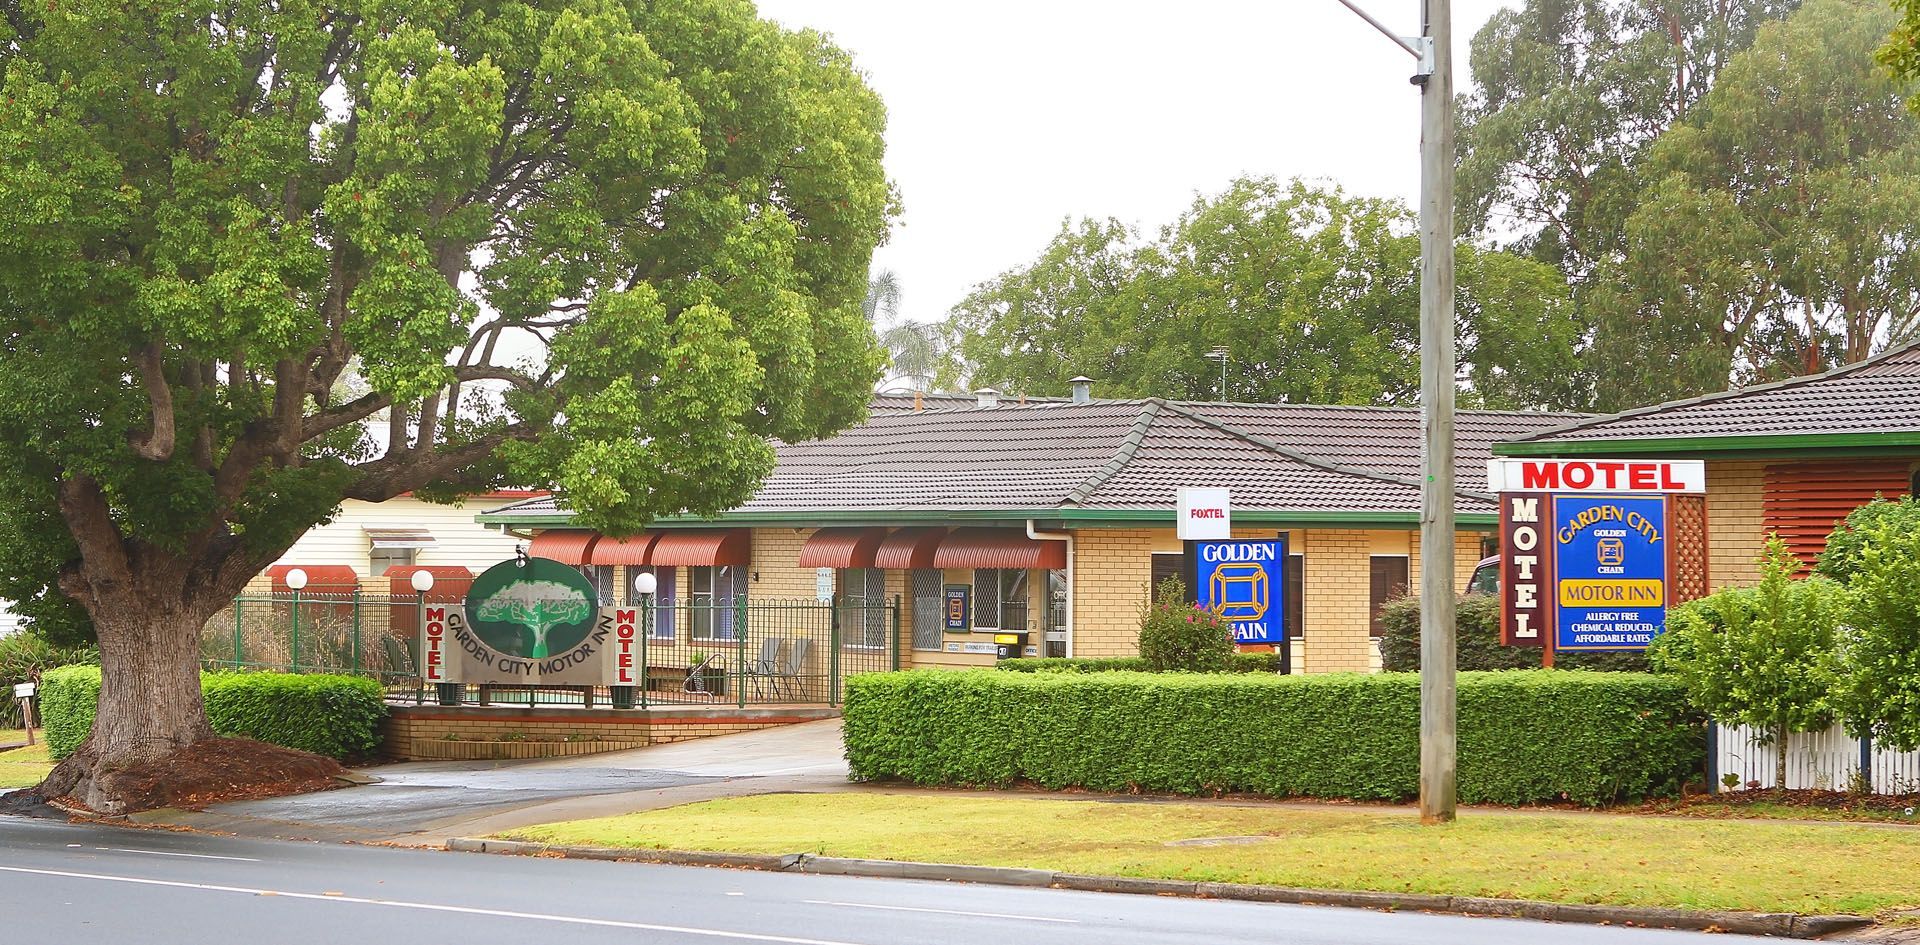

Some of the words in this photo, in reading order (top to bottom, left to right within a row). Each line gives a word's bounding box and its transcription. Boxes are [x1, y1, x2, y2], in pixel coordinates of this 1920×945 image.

[1522, 462, 1685, 490] MOTEL
[1191, 508, 1225, 519] FOXTEL
[1558, 505, 1624, 545] GARDEN
[1626, 511, 1663, 545] CITY
[1593, 529, 1627, 537] GOLDEN
[1203, 543, 1275, 562] GOLDEN
[1512, 498, 1538, 638] MOTEL
[1597, 566, 1625, 574] CHAIN
[1566, 585, 1624, 601] MOTOR
[1629, 585, 1657, 601] INN
[1585, 612, 1620, 621] ALLERGY
[1621, 612, 1639, 621] FREE
[1230, 622, 1267, 640] AIN
[1571, 623, 1614, 632] CHEMICAL
[1615, 623, 1653, 632] REDUCED
[426, 607, 445, 680] MOTEL
[447, 613, 495, 667] GARDEN
[498, 658, 534, 676] CITY
[538, 643, 596, 676] MOTOR
[592, 615, 614, 645] INN
[616, 609, 636, 683] MOTEL
[1574, 634, 1625, 643] AFFORDABLE
[1627, 634, 1651, 643] RATES
